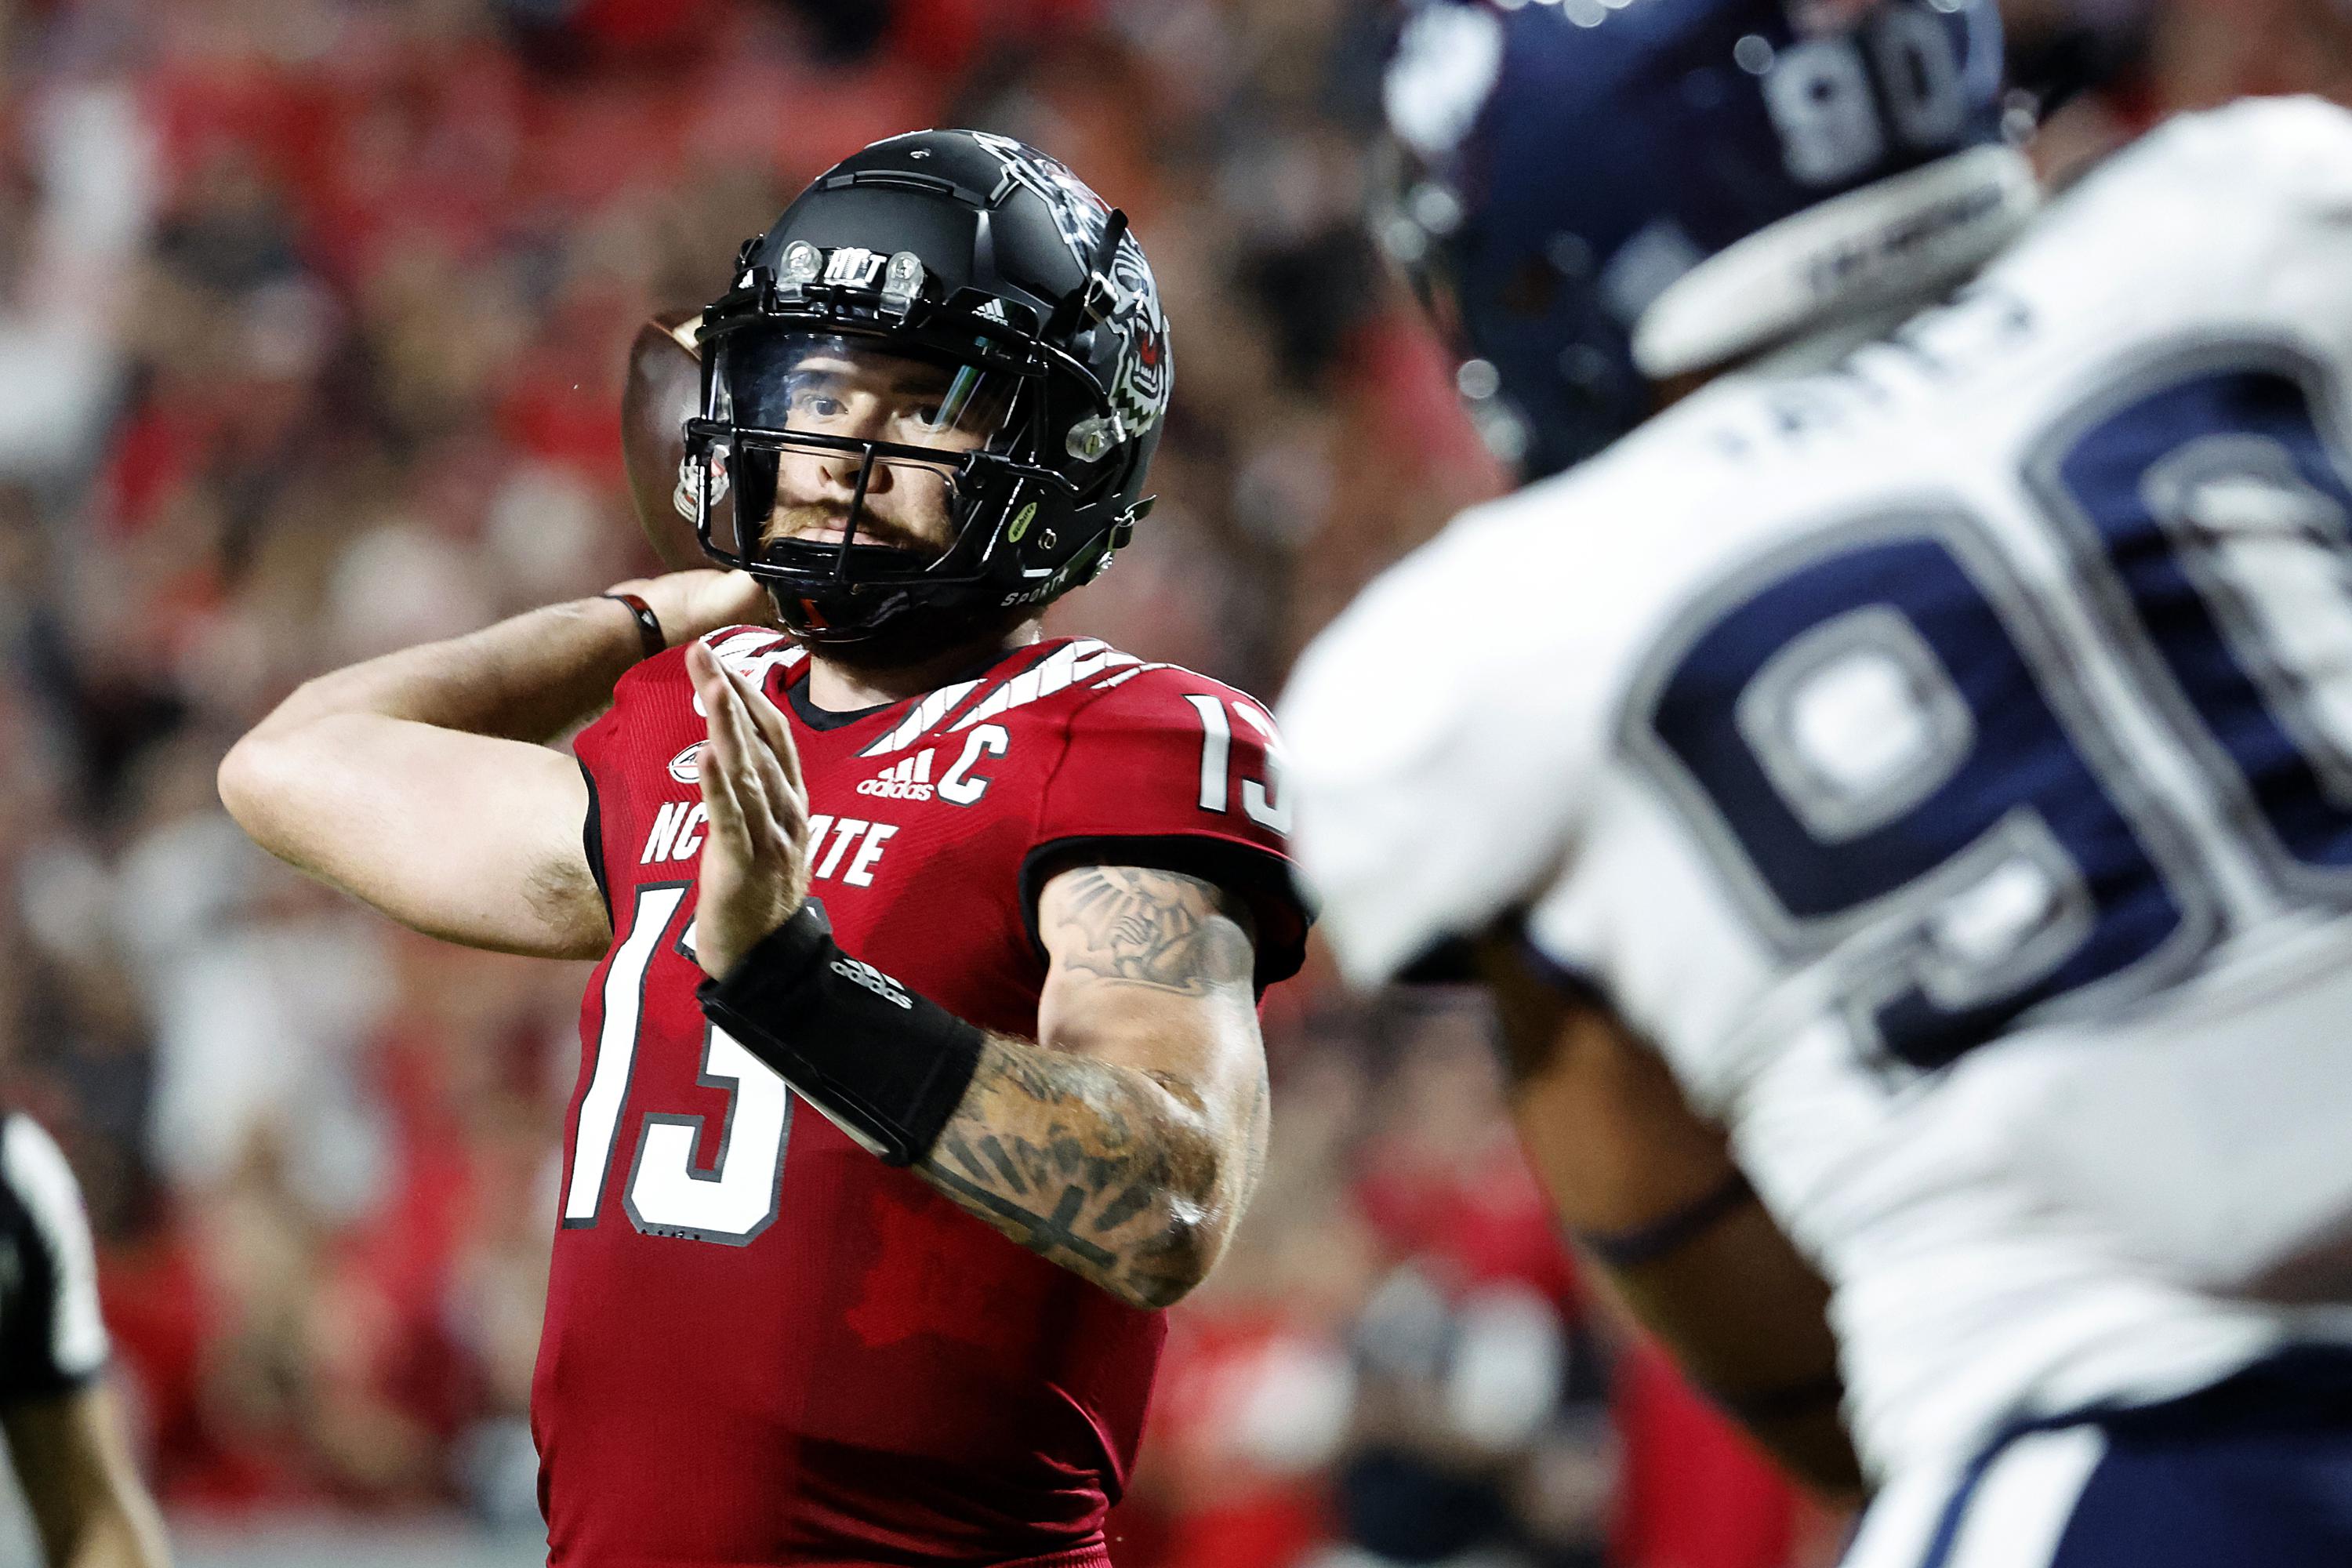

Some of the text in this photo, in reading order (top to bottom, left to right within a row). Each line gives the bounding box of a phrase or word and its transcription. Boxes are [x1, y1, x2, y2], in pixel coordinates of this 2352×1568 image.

[937, 723, 1010, 808] C
[1181, 693, 1295, 840] 13
[1611, 329, 2352, 1088] 90
[640, 800, 900, 888] NC ATE
[856, 779, 935, 801] adidas
[562, 880, 833, 1247] 13
